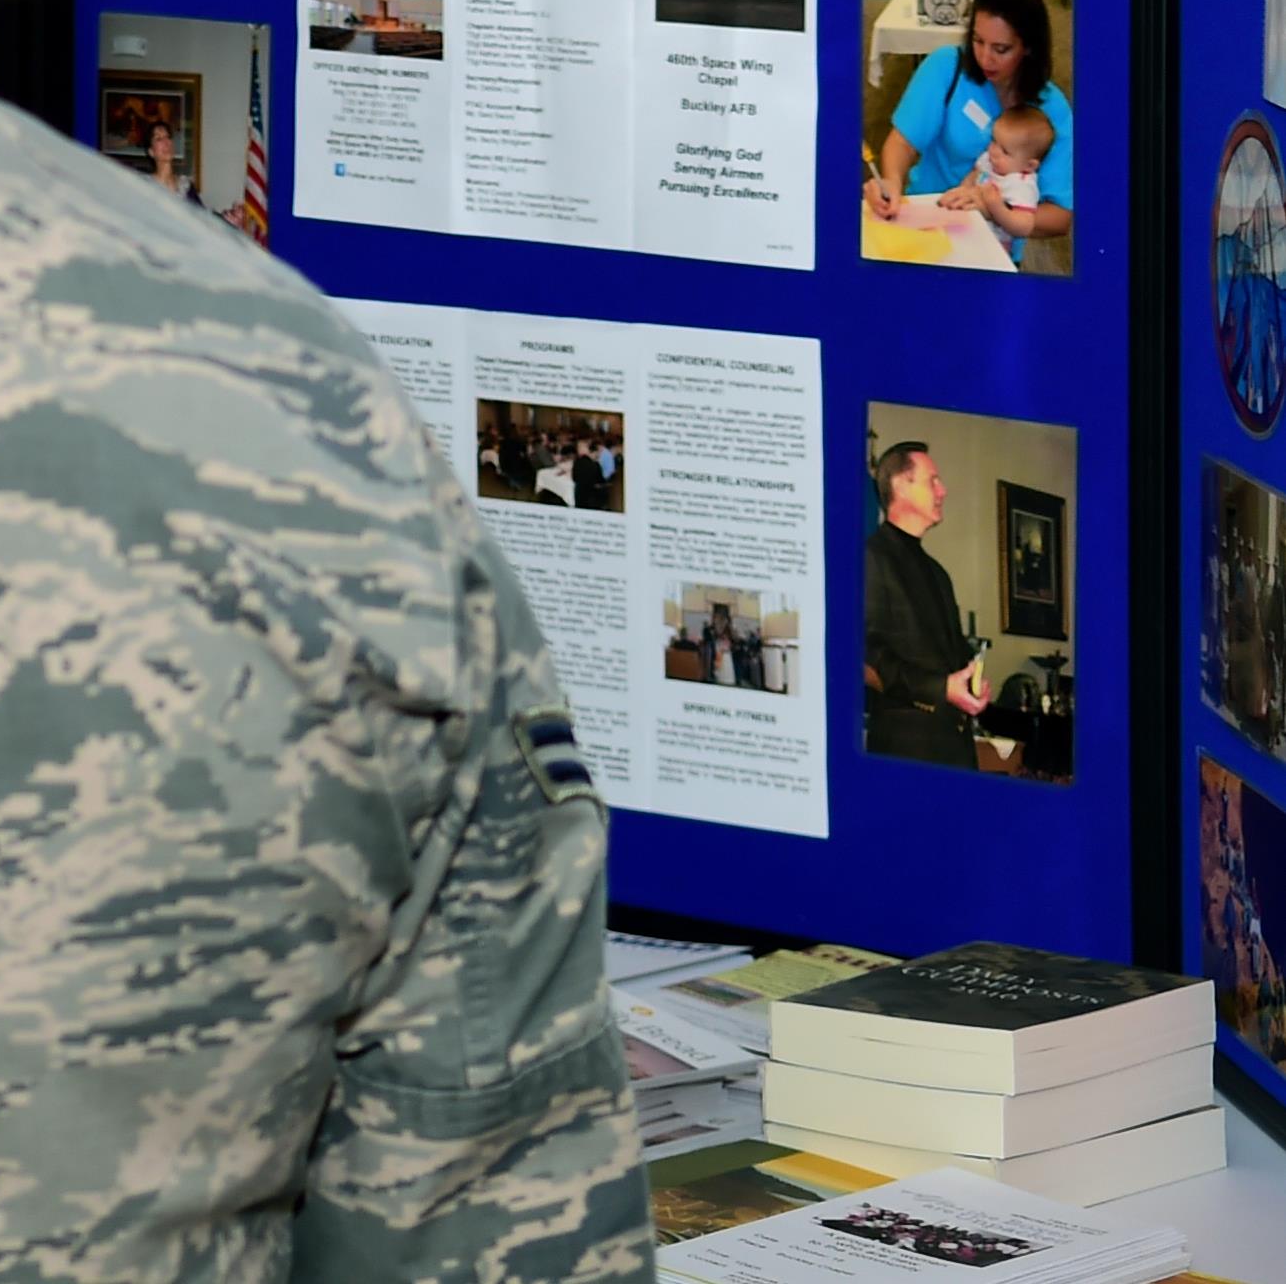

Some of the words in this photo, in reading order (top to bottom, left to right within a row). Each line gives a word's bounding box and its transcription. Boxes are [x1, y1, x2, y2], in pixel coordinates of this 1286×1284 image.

[666, 53, 698, 65] 460th
[702, 55, 736, 71] Space
[740, 59, 773, 75] Wing
[697, 72, 738, 88] Chapel
[681, 98, 726, 116] Buckley
[730, 103, 757, 116] AFB
[676, 143, 732, 162] Glorifying
[736, 148, 763, 162] God
[674, 162, 717, 179] Serving
[720, 169, 764, 180] Airmen
[659, 179, 710, 197] Pursuing
[713, 185, 779, 201] Excellence
[520, 340, 575, 354] PROGRAMS
[656, 353, 725, 368] CONFIDENTIAL
[729, 360, 795, 375] COUNSELING
[660, 469, 712, 483] STRONGER
[716, 475, 795, 492] RELATIONSHIPS
[684, 702, 731, 717] SPIRITUAL
[736, 710, 776, 723] FITNESS
